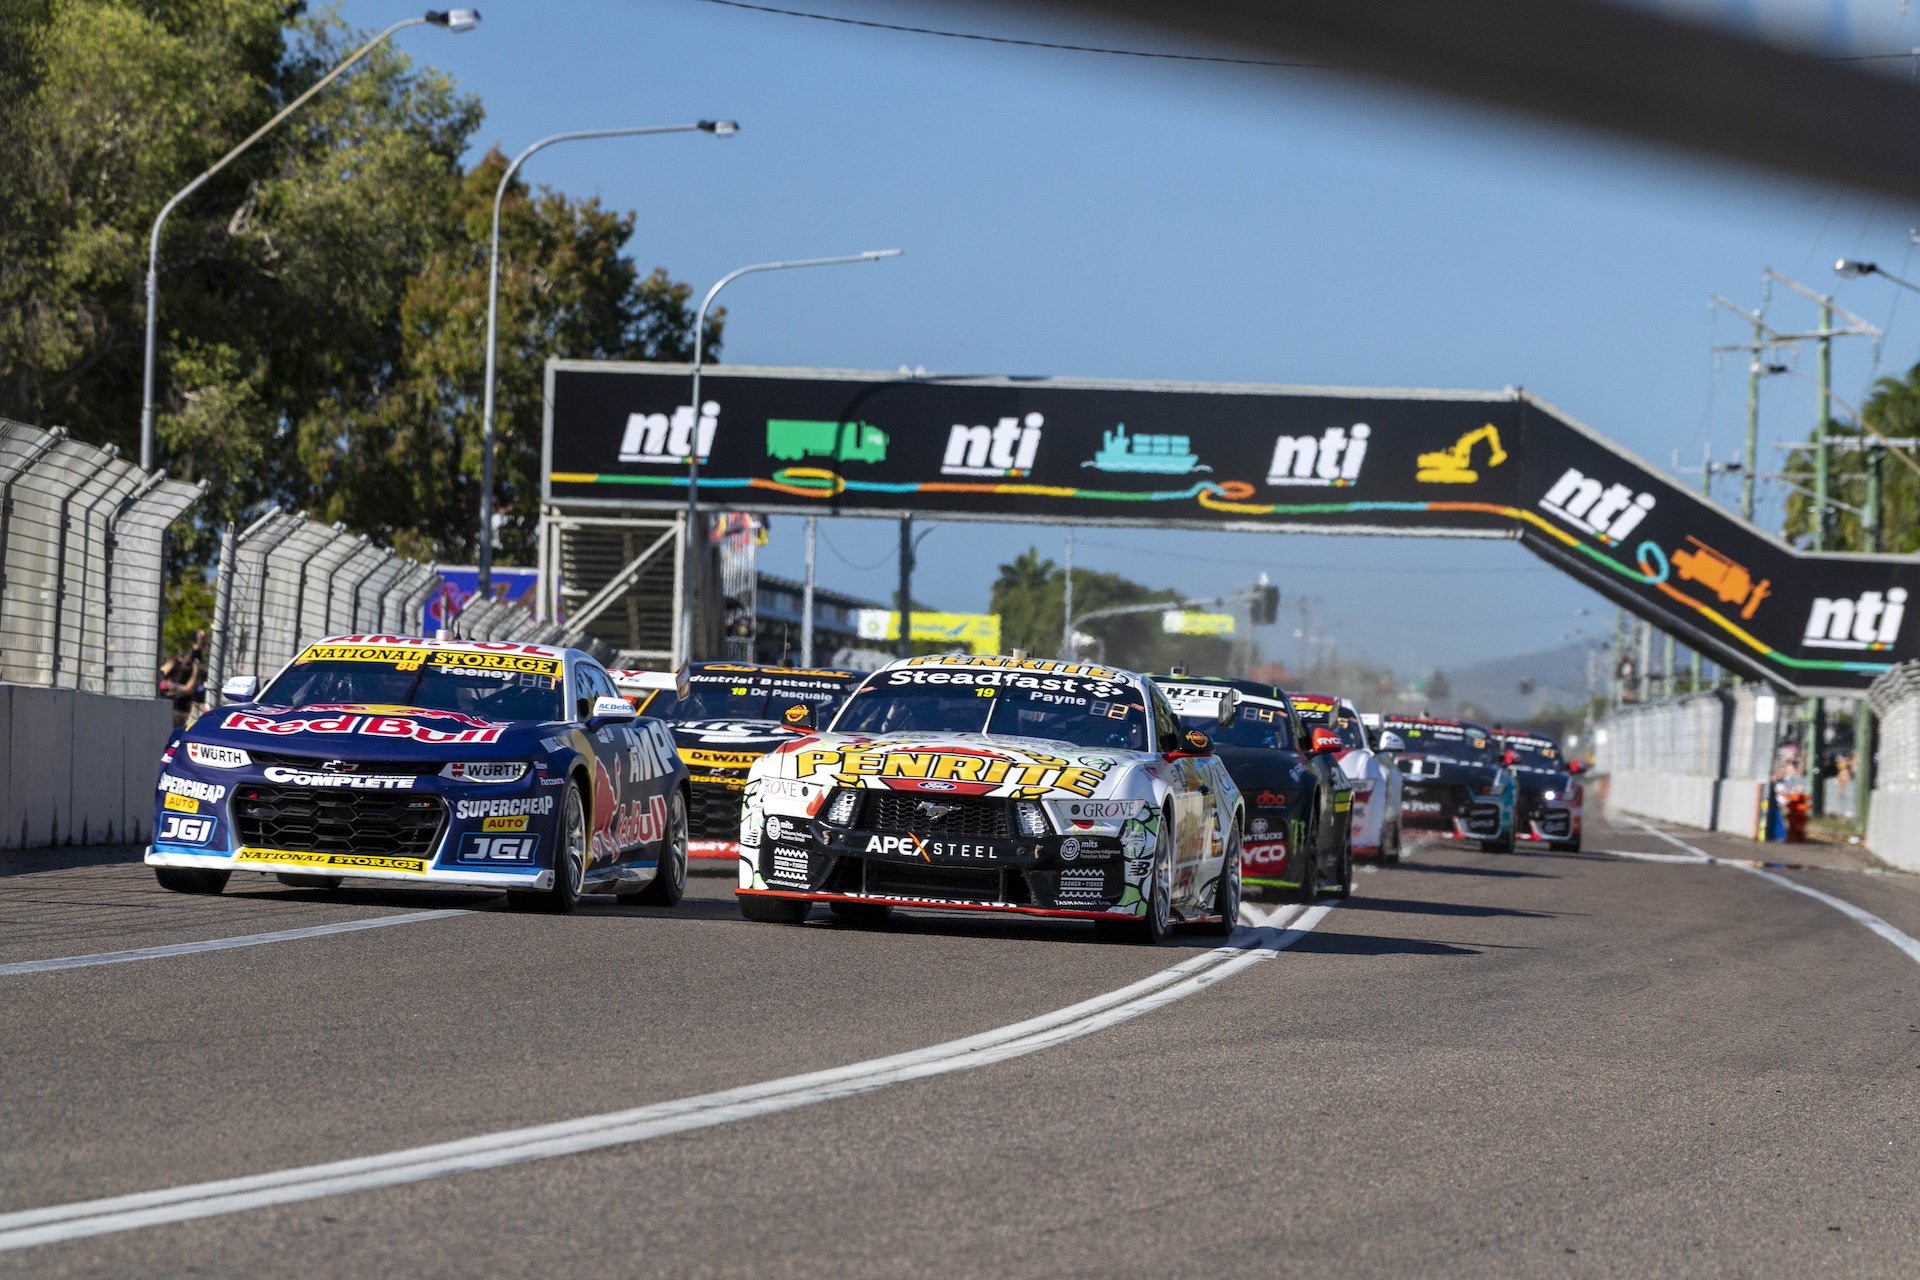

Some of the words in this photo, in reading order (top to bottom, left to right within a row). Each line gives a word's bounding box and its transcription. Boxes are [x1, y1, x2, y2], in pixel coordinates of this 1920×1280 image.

[620, 400, 720, 457] nti
[942, 411, 1044, 468] nti
[1267, 422, 1371, 479] nti
[1543, 467, 1656, 541] nti
[1804, 586, 1908, 643] nti
[322, 634, 555, 657] AMOL
[306, 648, 421, 661] NATIONAL
[434, 652, 553, 673] STORAGE
[396, 661, 419, 671] 88
[908, 657, 1116, 680] PENRITE
[440, 665, 516, 680] Feeney
[690, 675, 753, 684] dustrial
[760, 678, 841, 690] Batteries
[888, 671, 1078, 693] Steadfast
[731, 687, 747, 696] 18
[751, 687, 768, 697] De
[772, 690, 833, 702] Pasquale
[975, 688, 995, 697] 19
[1030, 691, 1086, 706] Payne
[220, 711, 361, 736] Red
[357, 716, 507, 745] Bull
[1317, 737, 1343, 745] RYC
[263, 766, 416, 789] COMPLETE
[796, 750, 1107, 797] PENRITE
[762, 778, 797, 797] ROVE
[1256, 790, 1285, 805] dba
[168, 796, 195, 809] AUTO
[456, 796, 554, 819] SUPERCHEAP
[1083, 803, 1134, 818] GROVE
[160, 817, 212, 842] JGI
[487, 819, 524, 828] AUTO
[463, 838, 534, 859] JGI
[866, 832, 932, 862] APEX
[933, 843, 998, 859] STEEL
[1081, 840, 1098, 848] mits
[1242, 845, 1286, 864] YCO
[239, 851, 325, 862] NATIONAL
[334, 856, 420, 869] STORAGE
